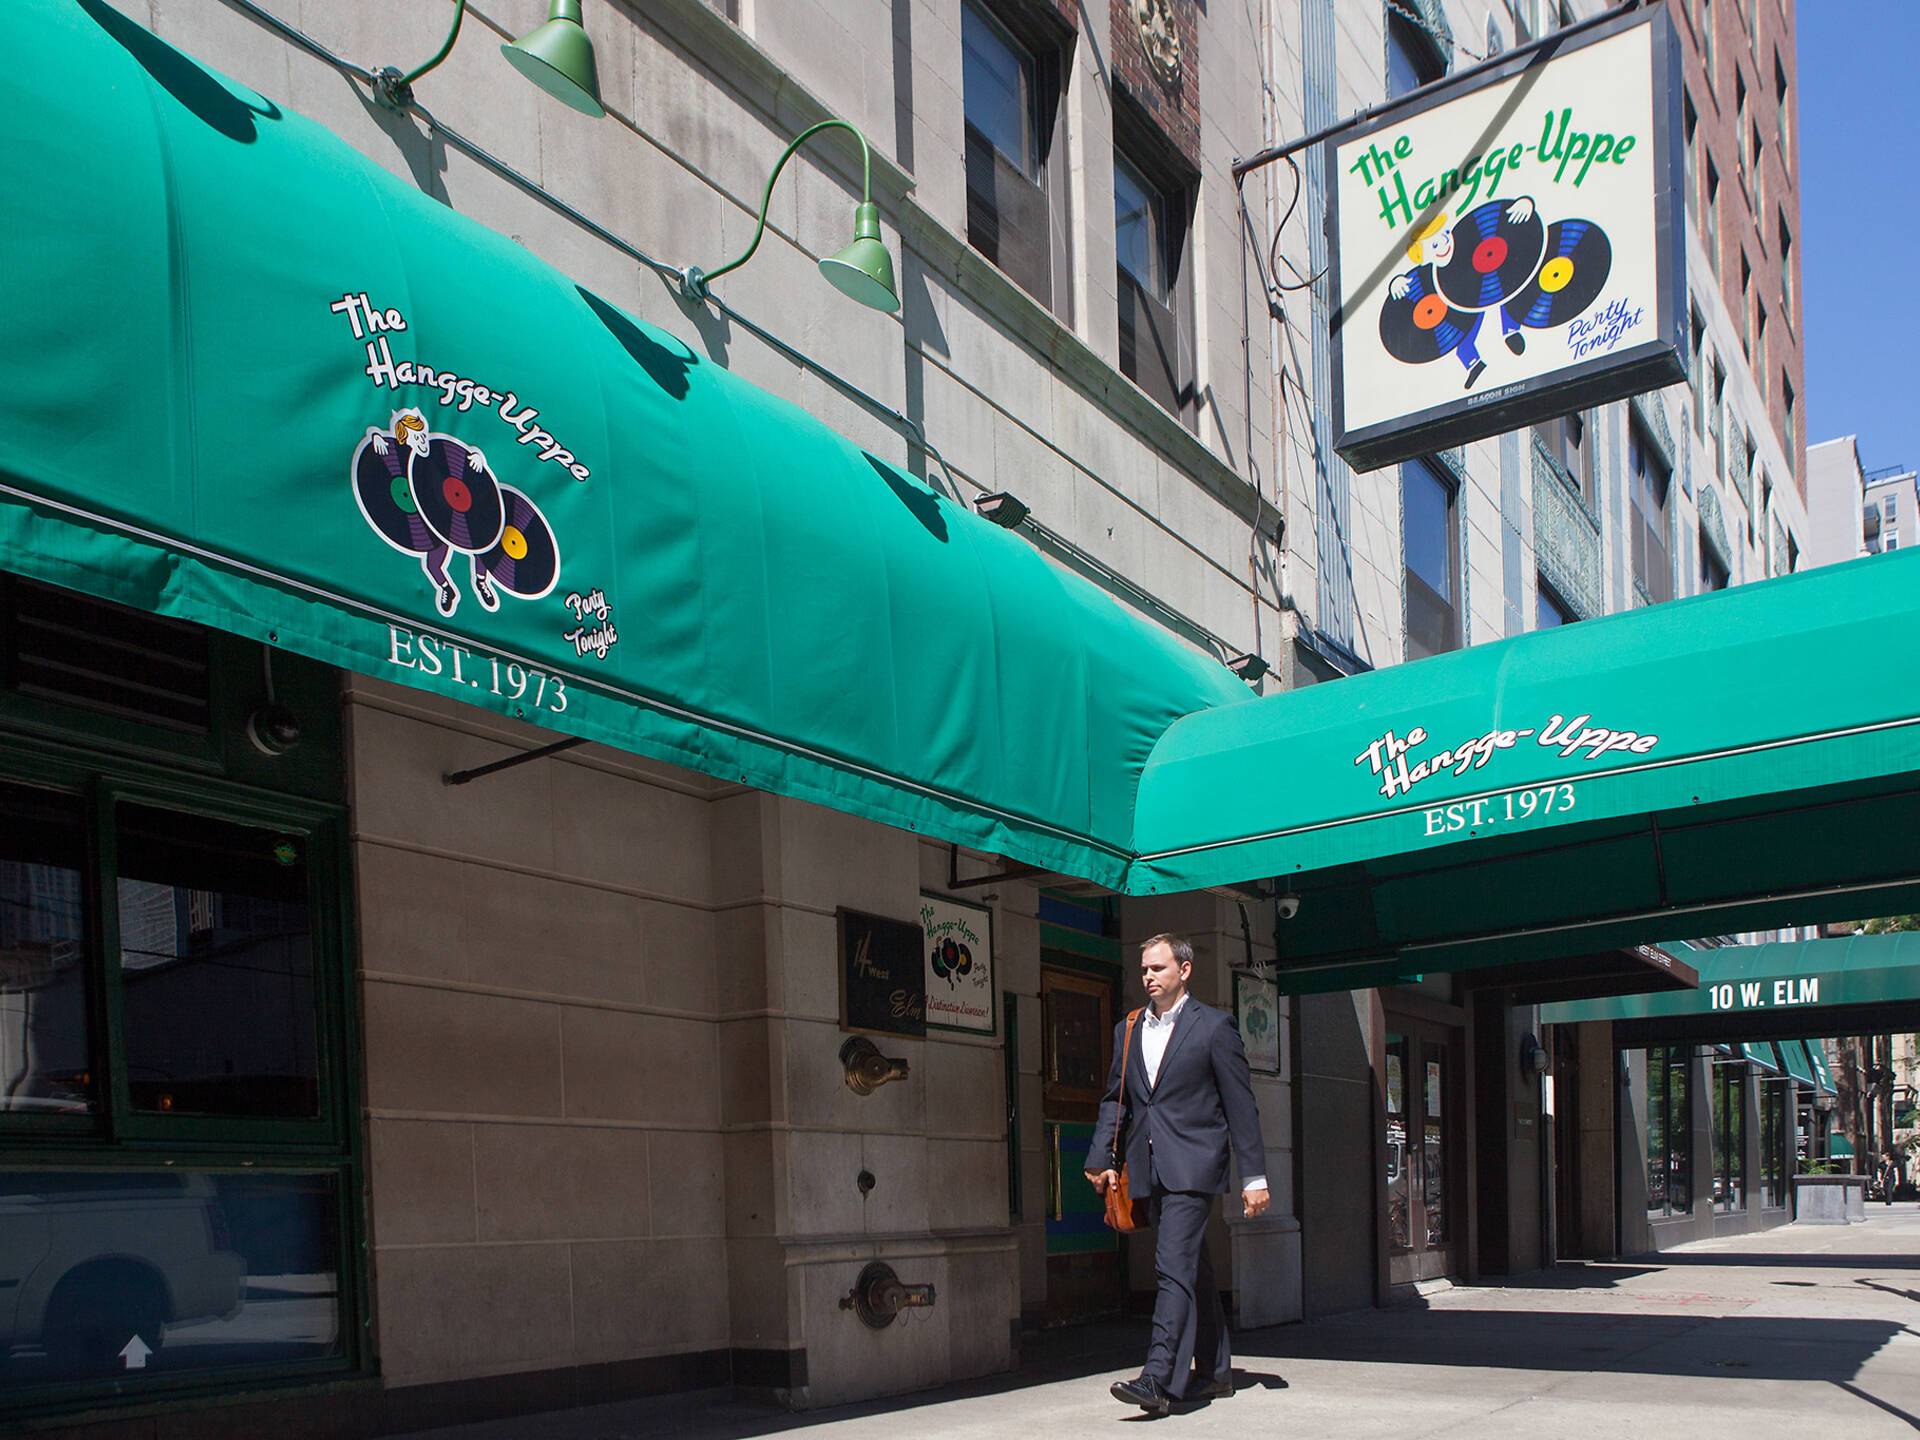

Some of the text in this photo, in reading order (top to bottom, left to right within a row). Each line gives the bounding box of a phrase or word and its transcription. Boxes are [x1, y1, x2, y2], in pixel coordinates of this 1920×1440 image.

[1349, 134, 1414, 188] The
[1377, 107, 1636, 229] Hangge-Uppe
[331, 292, 407, 339] The
[1567, 296, 1629, 345] Party
[1569, 306, 1646, 360] Tonight
[366, 337, 591, 482] Hangge-Uppe
[1467, 383, 1526, 406] BEACON SIGN
[564, 588, 611, 621] Party
[564, 621, 617, 659] Tonight
[386, 622, 568, 714] EST. 1973
[1354, 726, 1428, 775] The
[1423, 784, 1576, 837] EST. 1973
[853, 929, 872, 979] 14
[889, 988, 921, 1019] Elm
[1709, 978, 1819, 1010] 10 W. ELM
